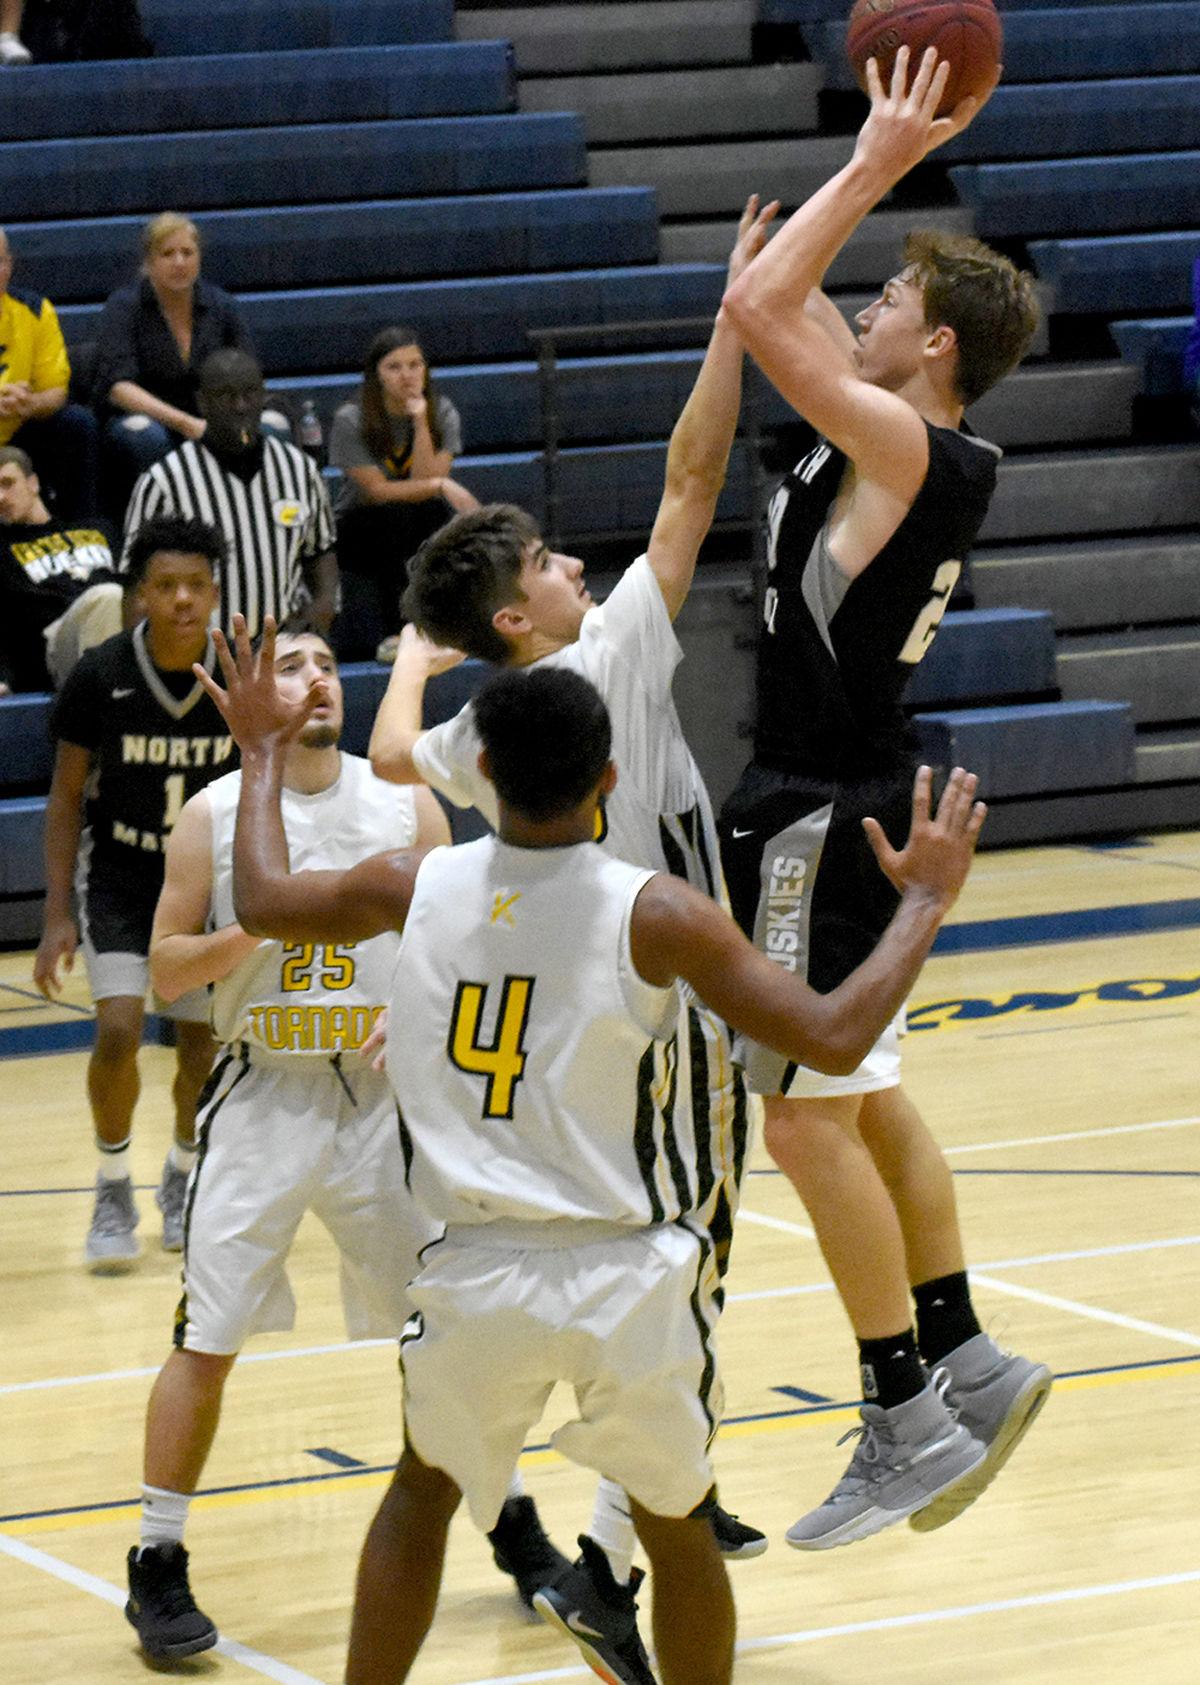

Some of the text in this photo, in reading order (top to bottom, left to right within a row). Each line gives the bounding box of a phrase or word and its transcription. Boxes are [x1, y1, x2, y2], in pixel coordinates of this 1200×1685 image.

[122, 734, 233, 767] NORTH
[163, 774, 185, 827] 1
[490, 891, 523, 928] K
[766, 856, 807, 972] USKIES
[281, 942, 356, 992] 25
[447, 974, 537, 1120] 4
